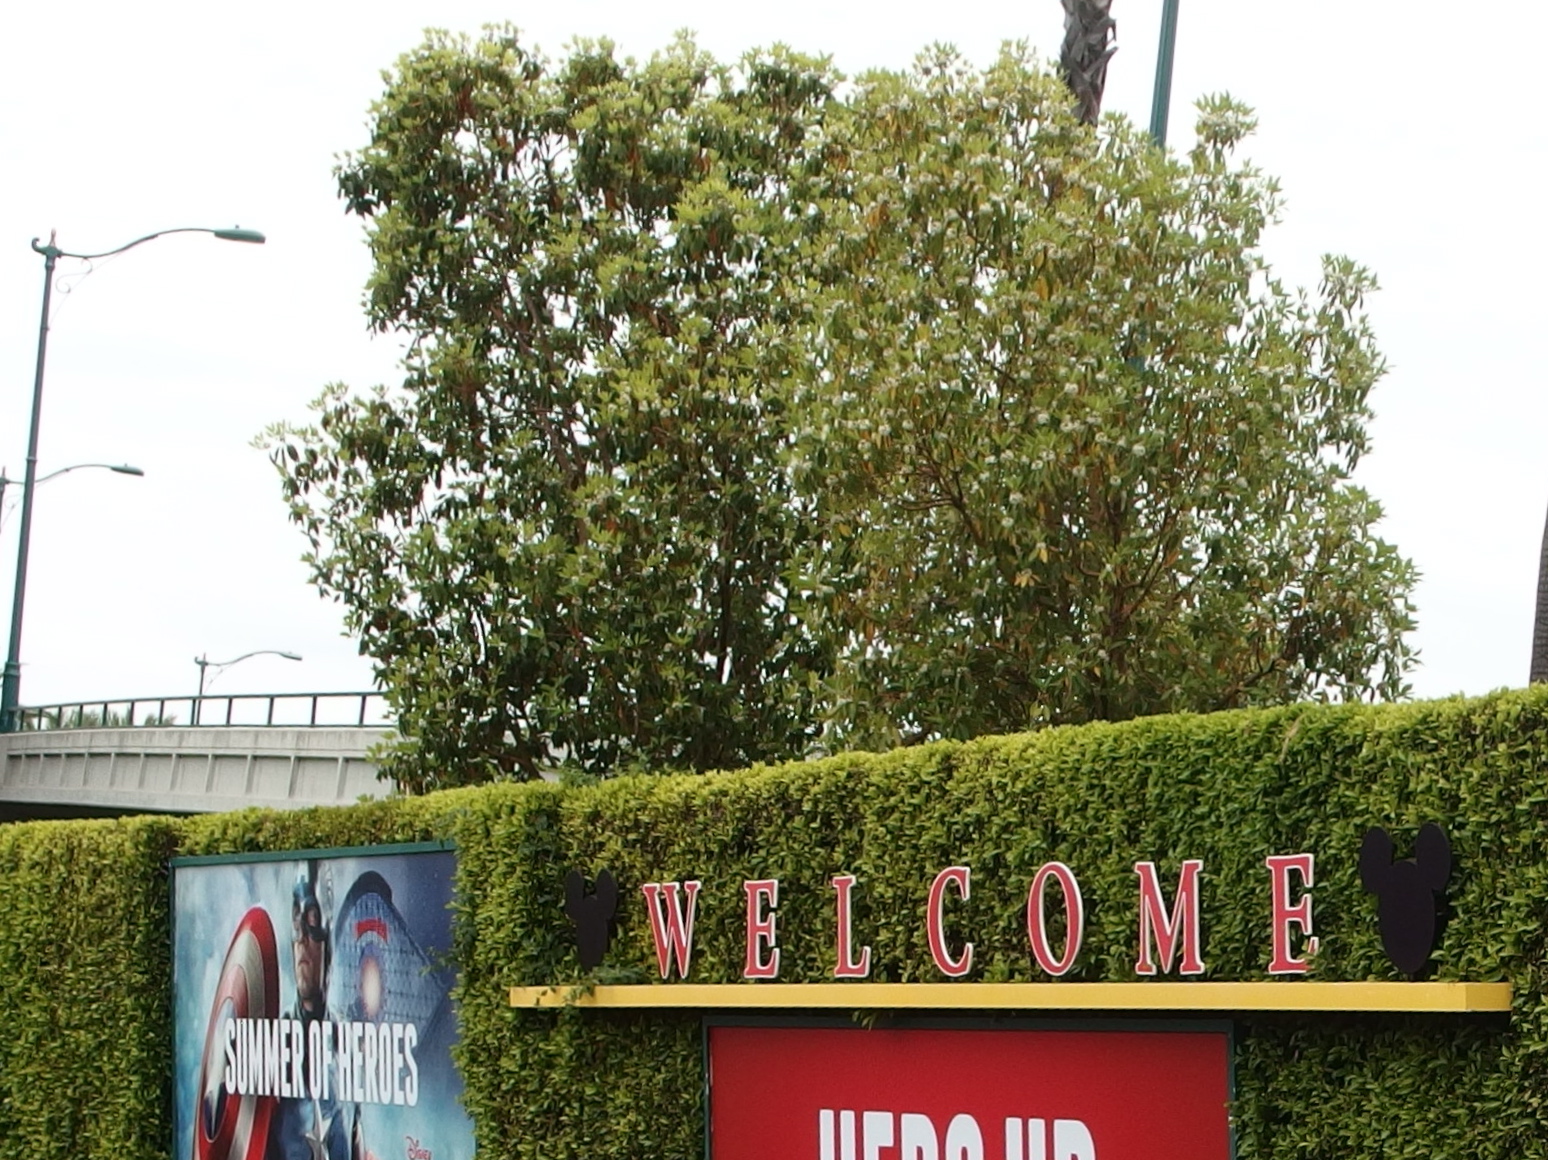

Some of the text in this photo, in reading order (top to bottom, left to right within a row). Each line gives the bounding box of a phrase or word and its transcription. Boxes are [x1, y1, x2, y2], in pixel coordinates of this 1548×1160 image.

[642, 853, 1319, 979] WELCOME
[224, 1017, 419, 1107] SUMMER OF HEROES
